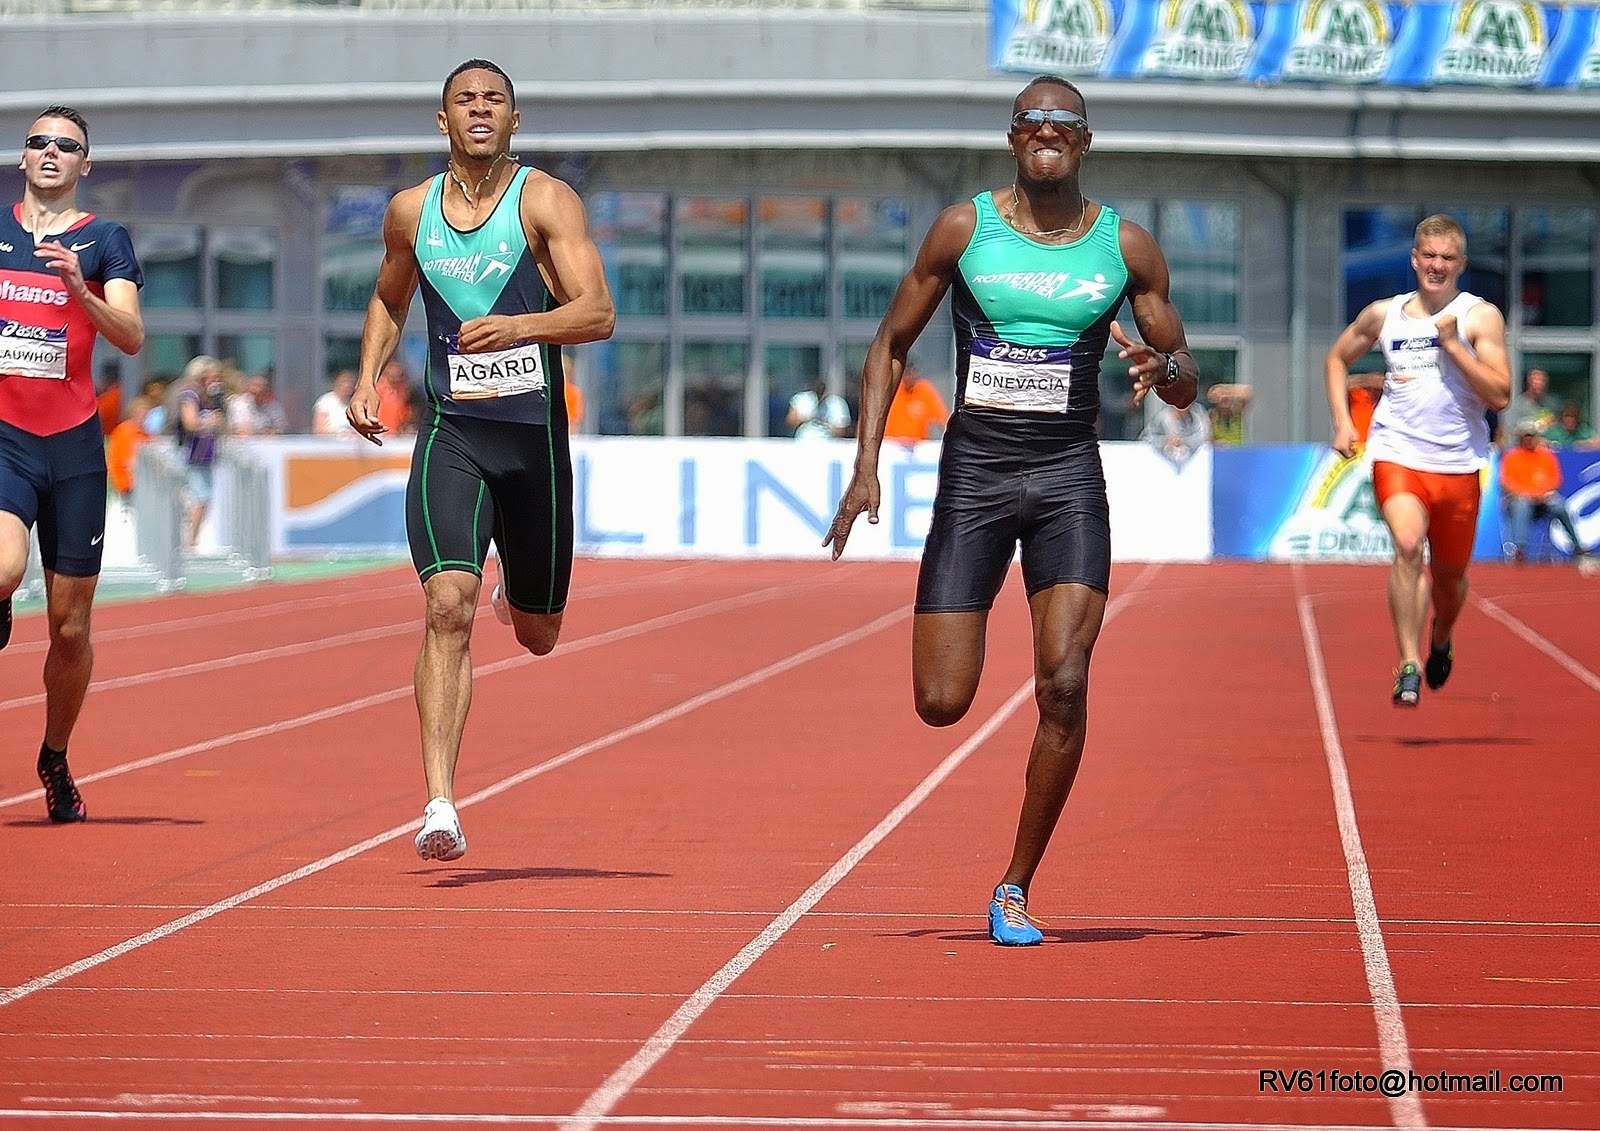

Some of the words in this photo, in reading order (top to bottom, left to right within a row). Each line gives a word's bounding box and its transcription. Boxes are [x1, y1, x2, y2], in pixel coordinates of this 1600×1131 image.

[423, 250, 484, 273] ROTTERDAM
[971, 272, 1071, 289] ROTTERDAM
[0, 280, 70, 305] hanos
[1006, 346, 1048, 362] asics
[455, 356, 537, 382] AGARD
[971, 371, 1065, 391] BONEVACIA
